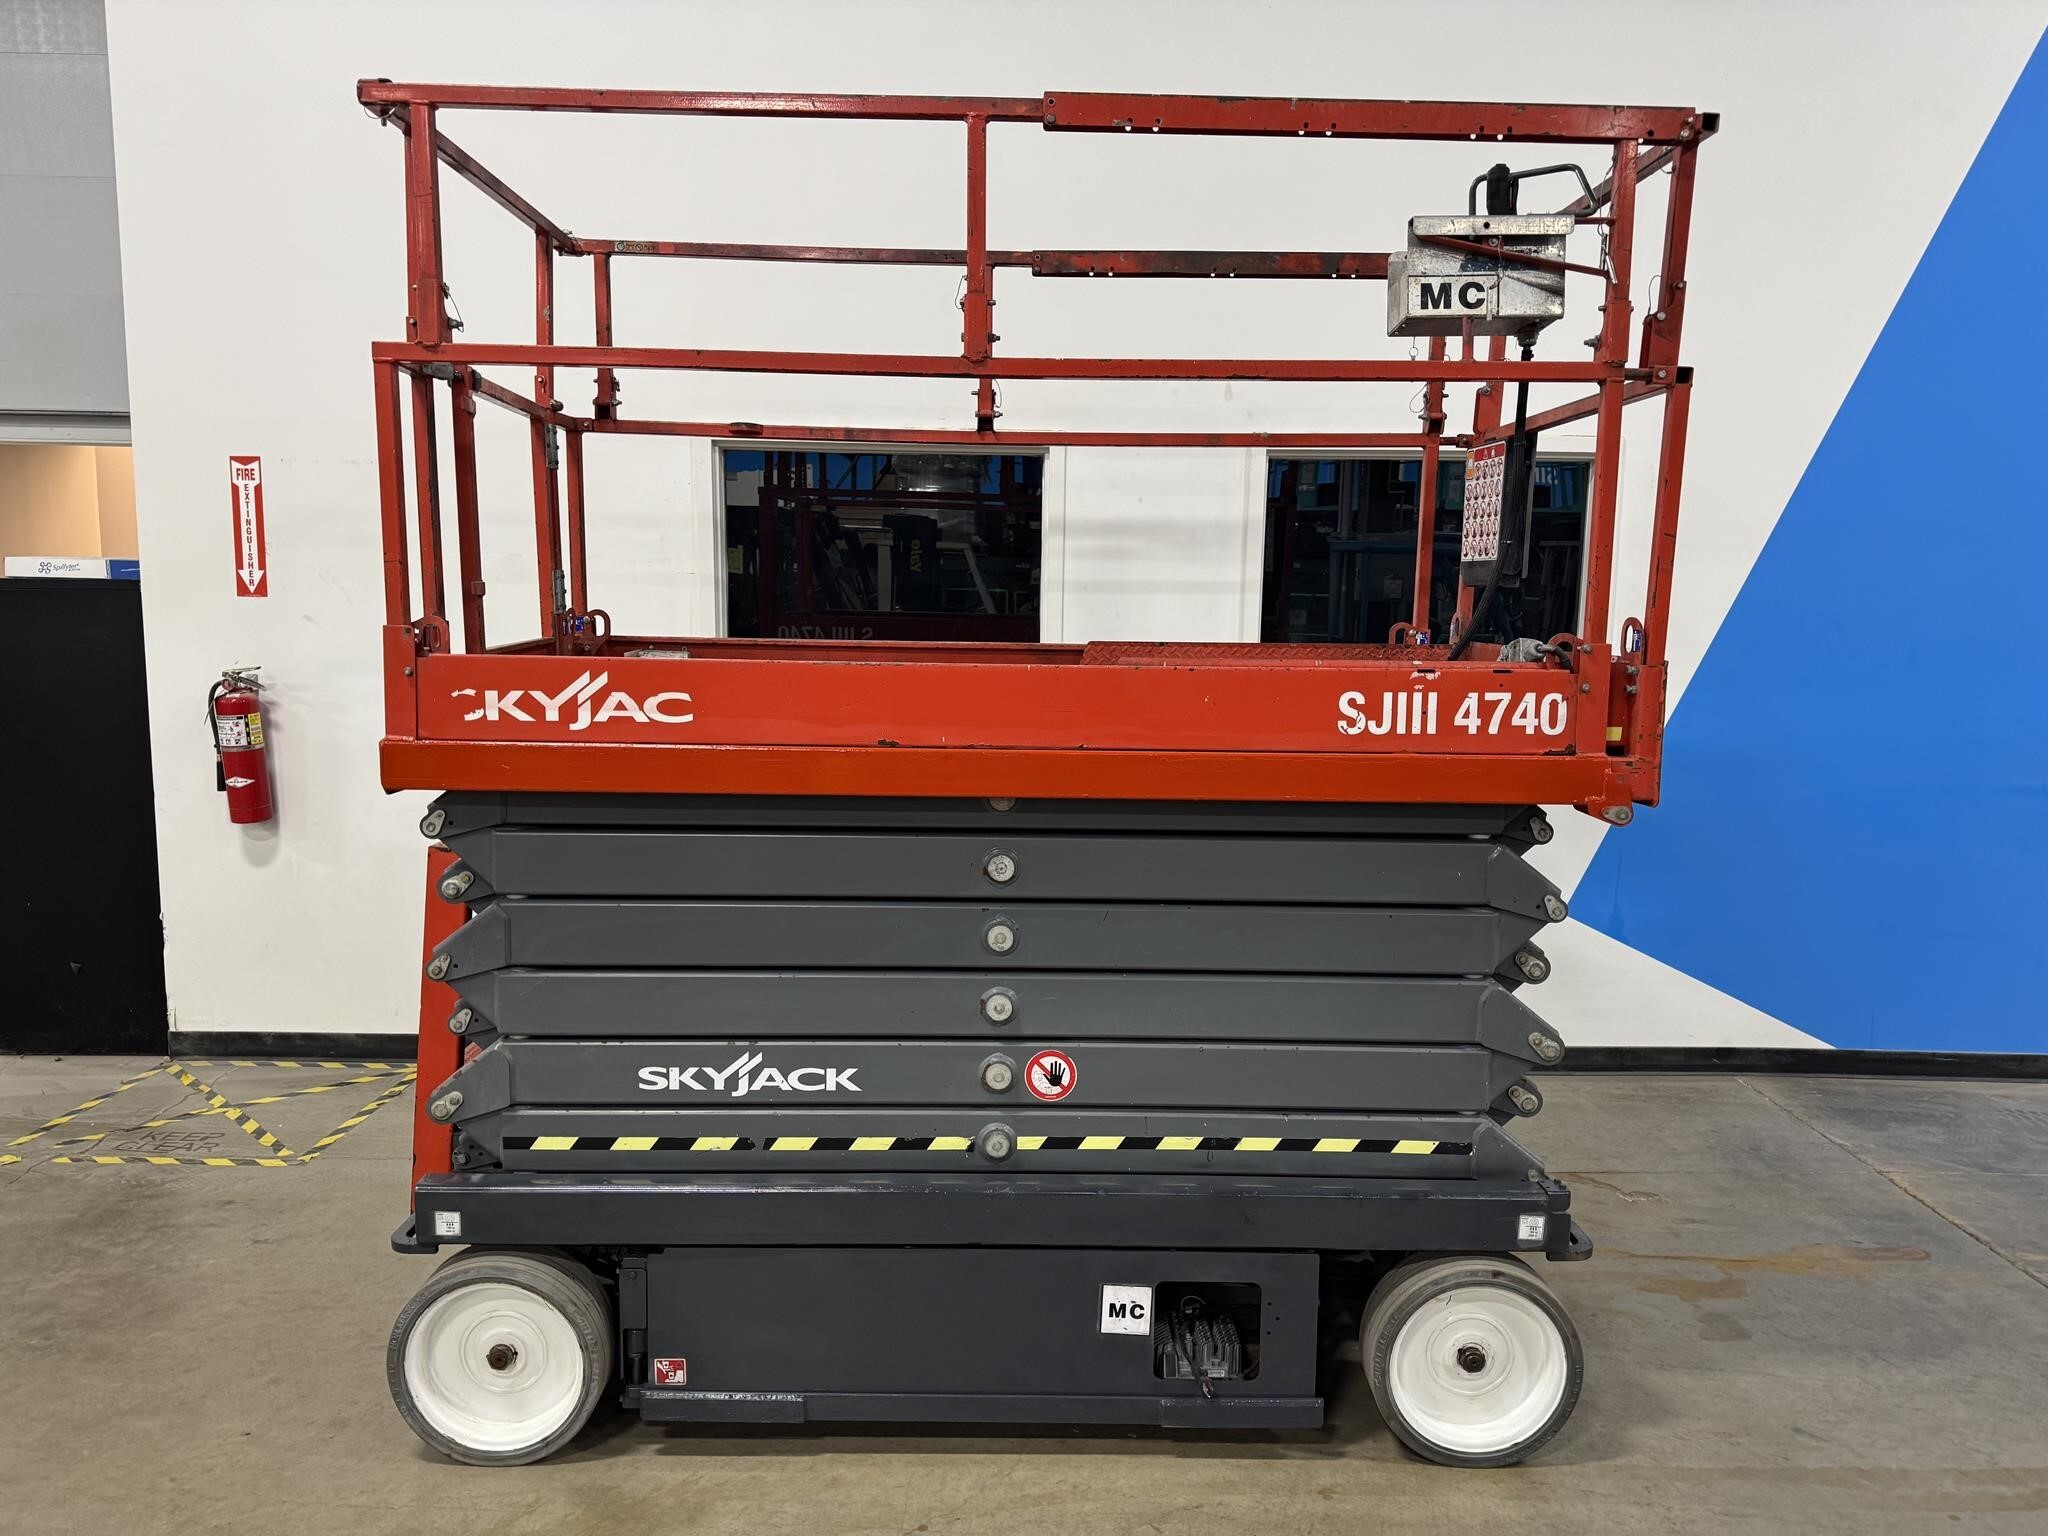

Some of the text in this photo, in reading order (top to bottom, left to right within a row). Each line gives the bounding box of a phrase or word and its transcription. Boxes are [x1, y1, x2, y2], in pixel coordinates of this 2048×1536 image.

[236, 468, 255, 481] FIRE
[244, 484, 255, 587] EXTINGUISHER
[1454, 691, 1567, 736] 4740
[638, 1051, 862, 1097] SKYJACK
[140, 1131, 225, 1141] KEEP
[1109, 1303, 1145, 1320] MC
